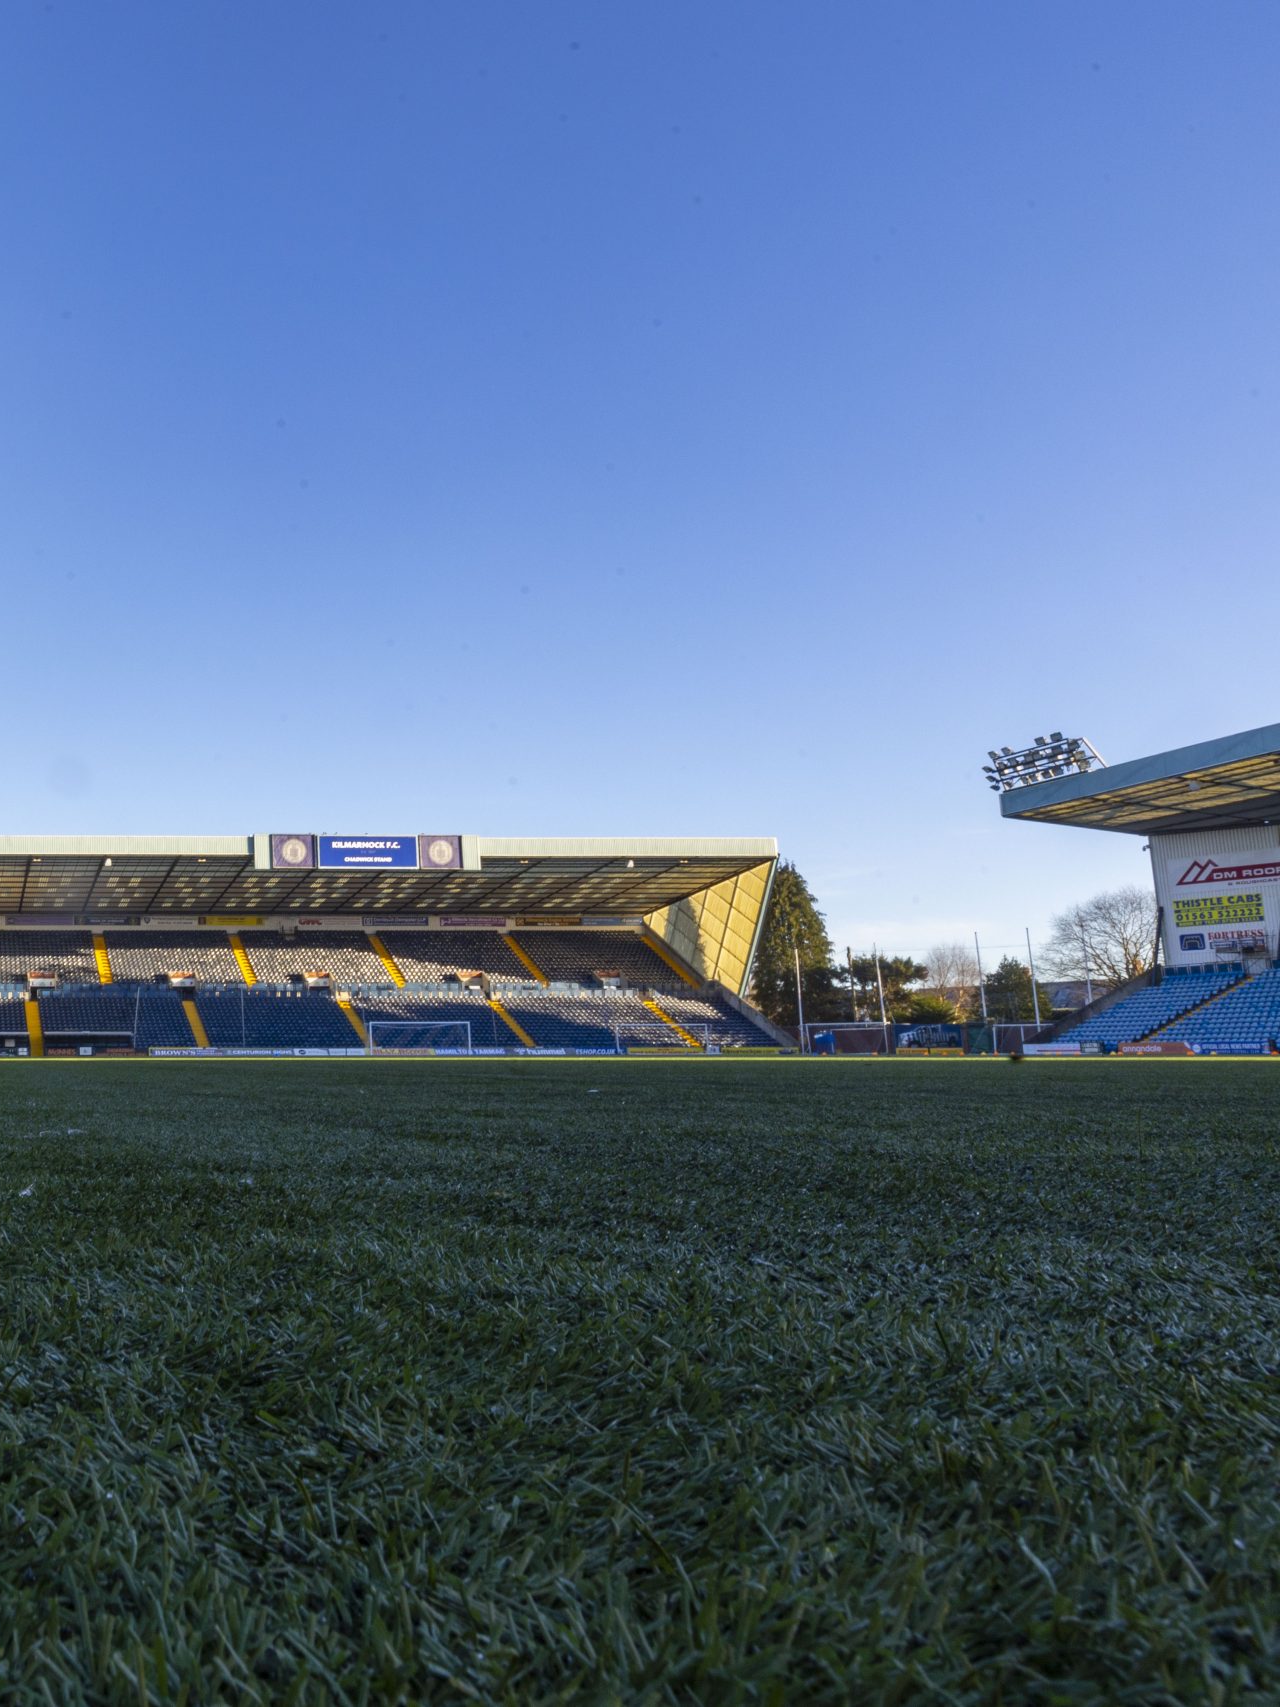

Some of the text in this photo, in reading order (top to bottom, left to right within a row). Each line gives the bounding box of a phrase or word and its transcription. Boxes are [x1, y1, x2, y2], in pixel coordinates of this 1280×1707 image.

[332, 841, 401, 849] KILMARNOCK F.C.
[1213, 871, 1237, 879] DM
[1174, 897, 1224, 909] THISTLE
[1227, 894, 1262, 905] CABS
[1176, 911, 1214, 922] 01563
[1218, 907, 1262, 918] 522222
[1208, 929, 1264, 941] FORTRESS
[1122, 1045, 1162, 1053] annandale
